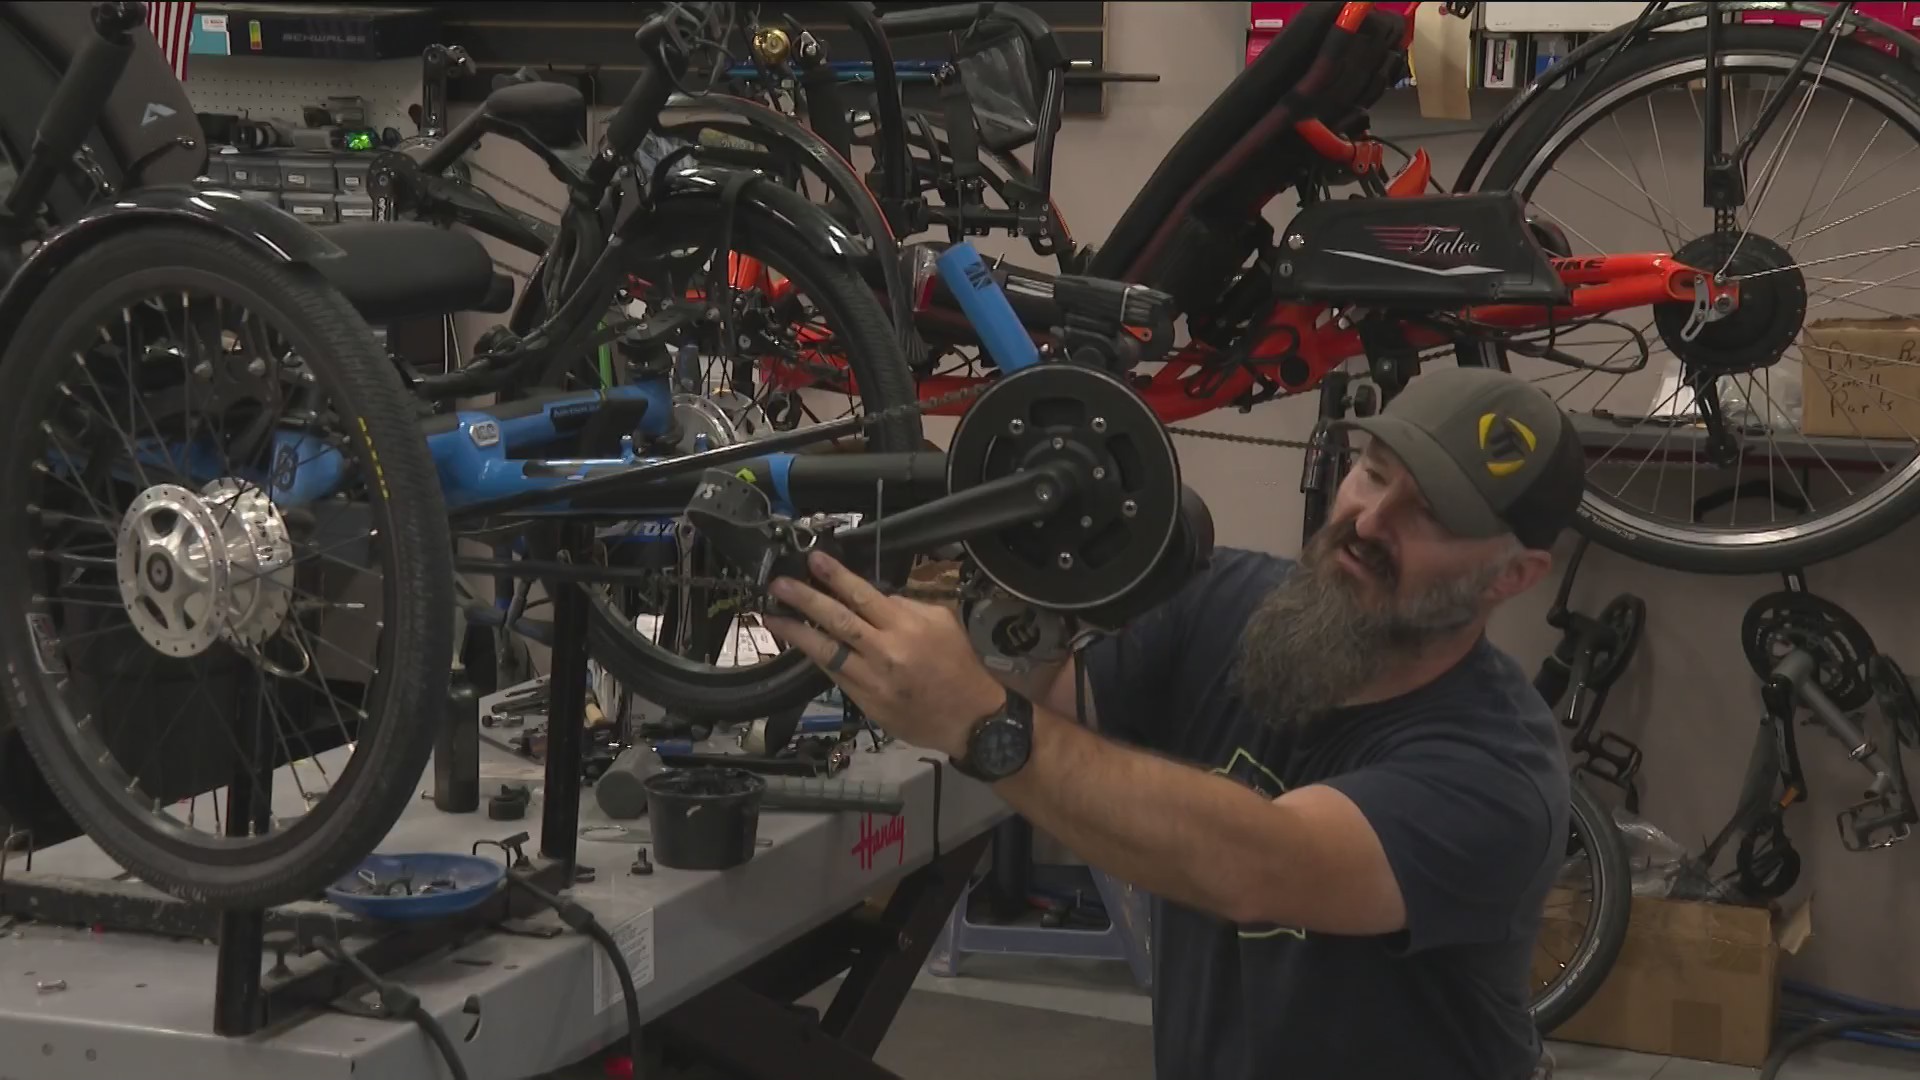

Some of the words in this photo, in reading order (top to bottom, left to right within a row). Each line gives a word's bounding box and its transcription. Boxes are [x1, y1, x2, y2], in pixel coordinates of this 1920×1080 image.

[282, 32, 366, 43] SCHWALBE
[1408, 226, 1481, 256] Falco
[1830, 389, 1893, 418] Parts
[851, 811, 904, 870] Handy
